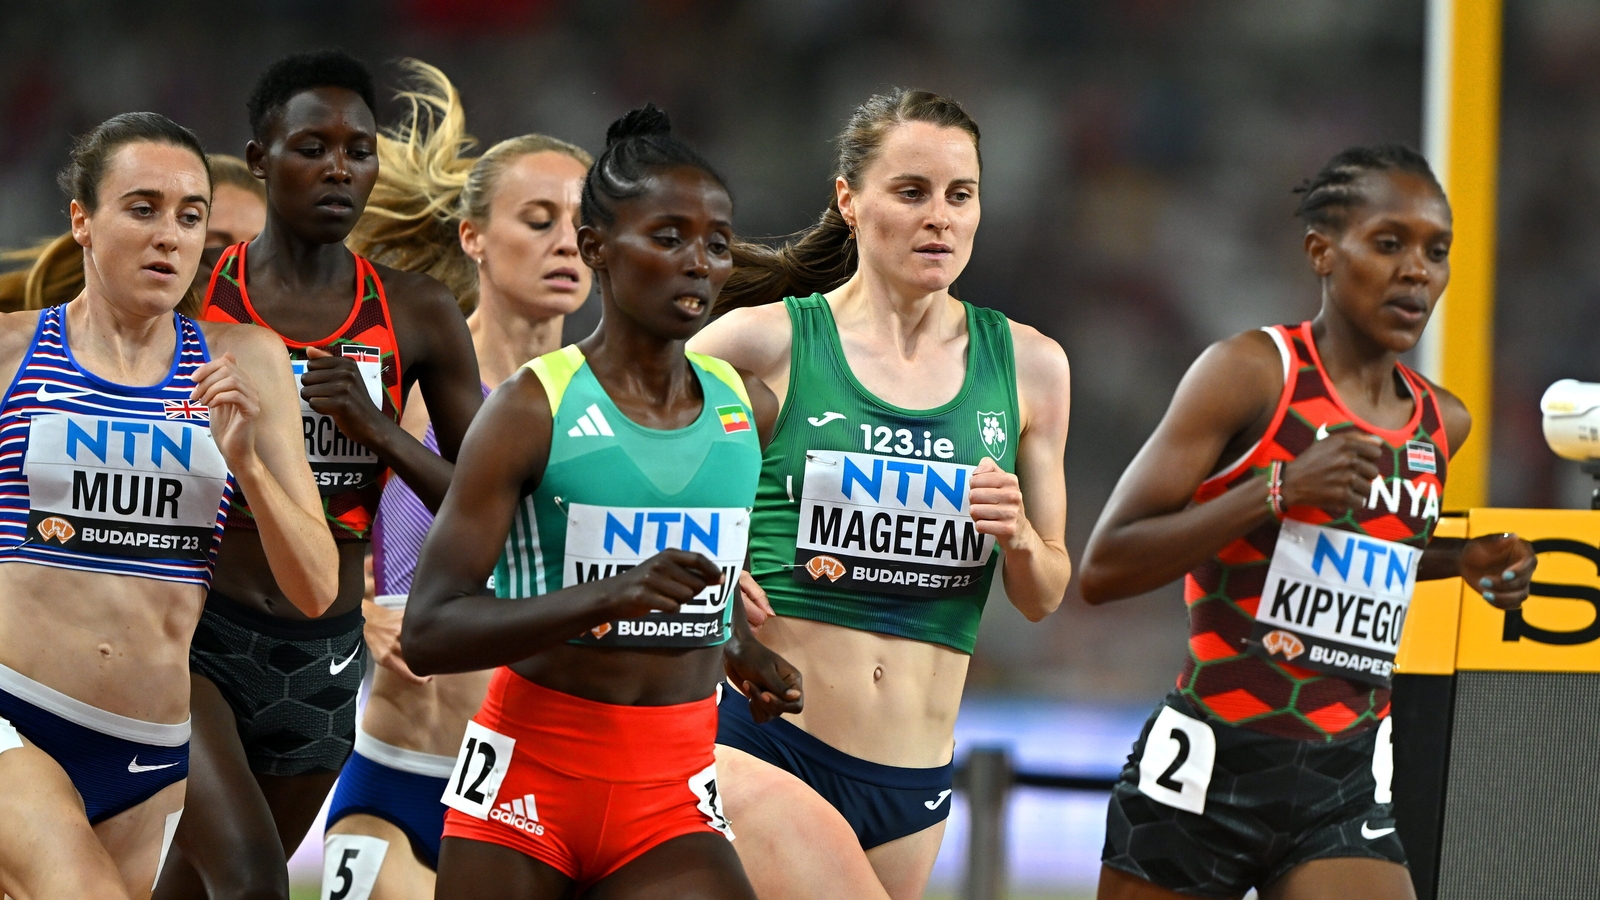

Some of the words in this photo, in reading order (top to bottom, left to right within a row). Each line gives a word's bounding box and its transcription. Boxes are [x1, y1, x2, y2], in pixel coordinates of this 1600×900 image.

[66, 418, 192, 472] NTN
[860, 424, 954, 458] 123.ie
[72, 470, 183, 519] MUIR
[343, 472, 363, 485] 23
[841, 455, 966, 513] NTN
[1362, 474, 1440, 523] NYA
[81, 527, 180, 550] BUDAPEST
[182, 536, 199, 550] 23
[604, 511, 720, 557] NTN
[809, 504, 985, 562] MAGEEAN
[852, 566, 952, 588] BUDAPEST
[952, 575, 971, 588] 23
[1311, 530, 1413, 594] NTN
[618, 620, 711, 637] BUDAPEST
[455, 737, 497, 805] 12
[1156, 728, 1190, 793] 2
[490, 808, 545, 836] adidas
[330, 848, 361, 900] 5
